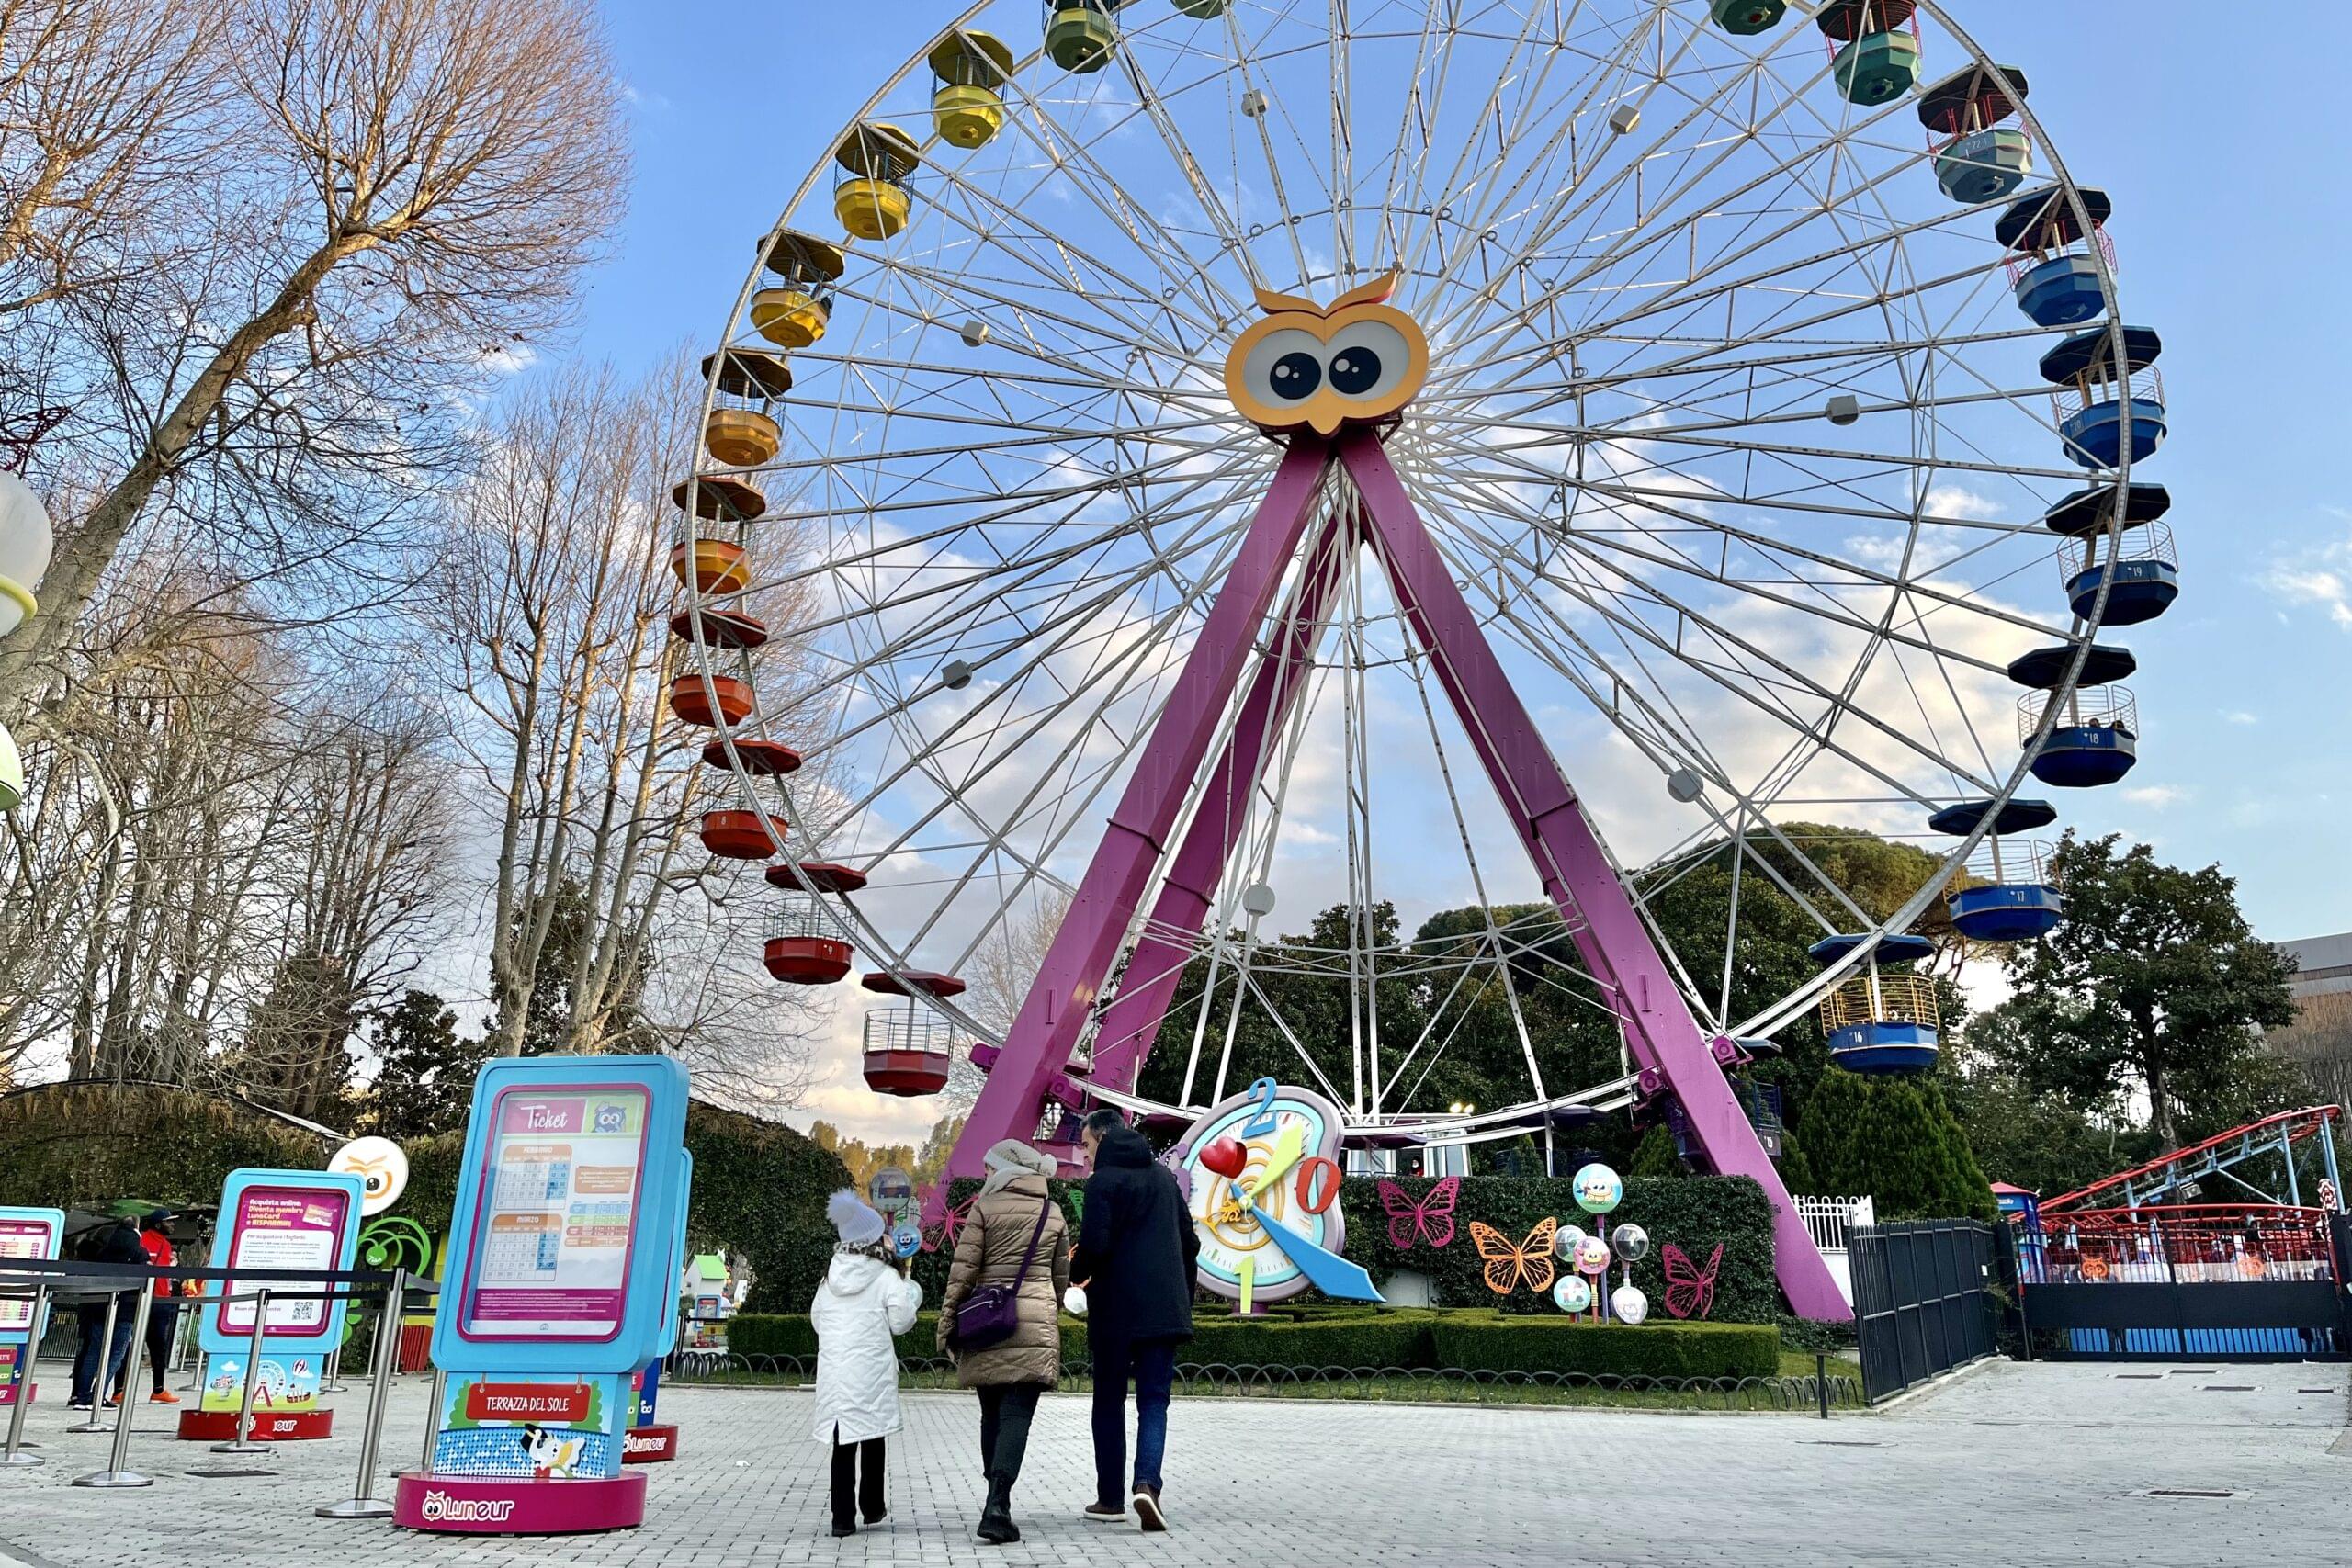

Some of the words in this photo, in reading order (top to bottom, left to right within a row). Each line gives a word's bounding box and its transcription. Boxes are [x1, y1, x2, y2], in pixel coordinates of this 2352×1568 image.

[2133, 566, 2142, 577] 19
[2089, 732, 2099, 744] 18
[2017, 890, 2025, 902] 17
[1854, 1031, 1863, 1043] 16
[1241, 1077, 1277, 1139] 2
[520, 1105, 568, 1129] Ticket
[486, 1397, 528, 1412] TERRAZZA
[529, 1397, 547, 1412] DEL
[547, 1397, 570, 1412] SOLE
[631, 1436, 667, 1452] Luneur
[445, 1496, 515, 1520] Luneur
